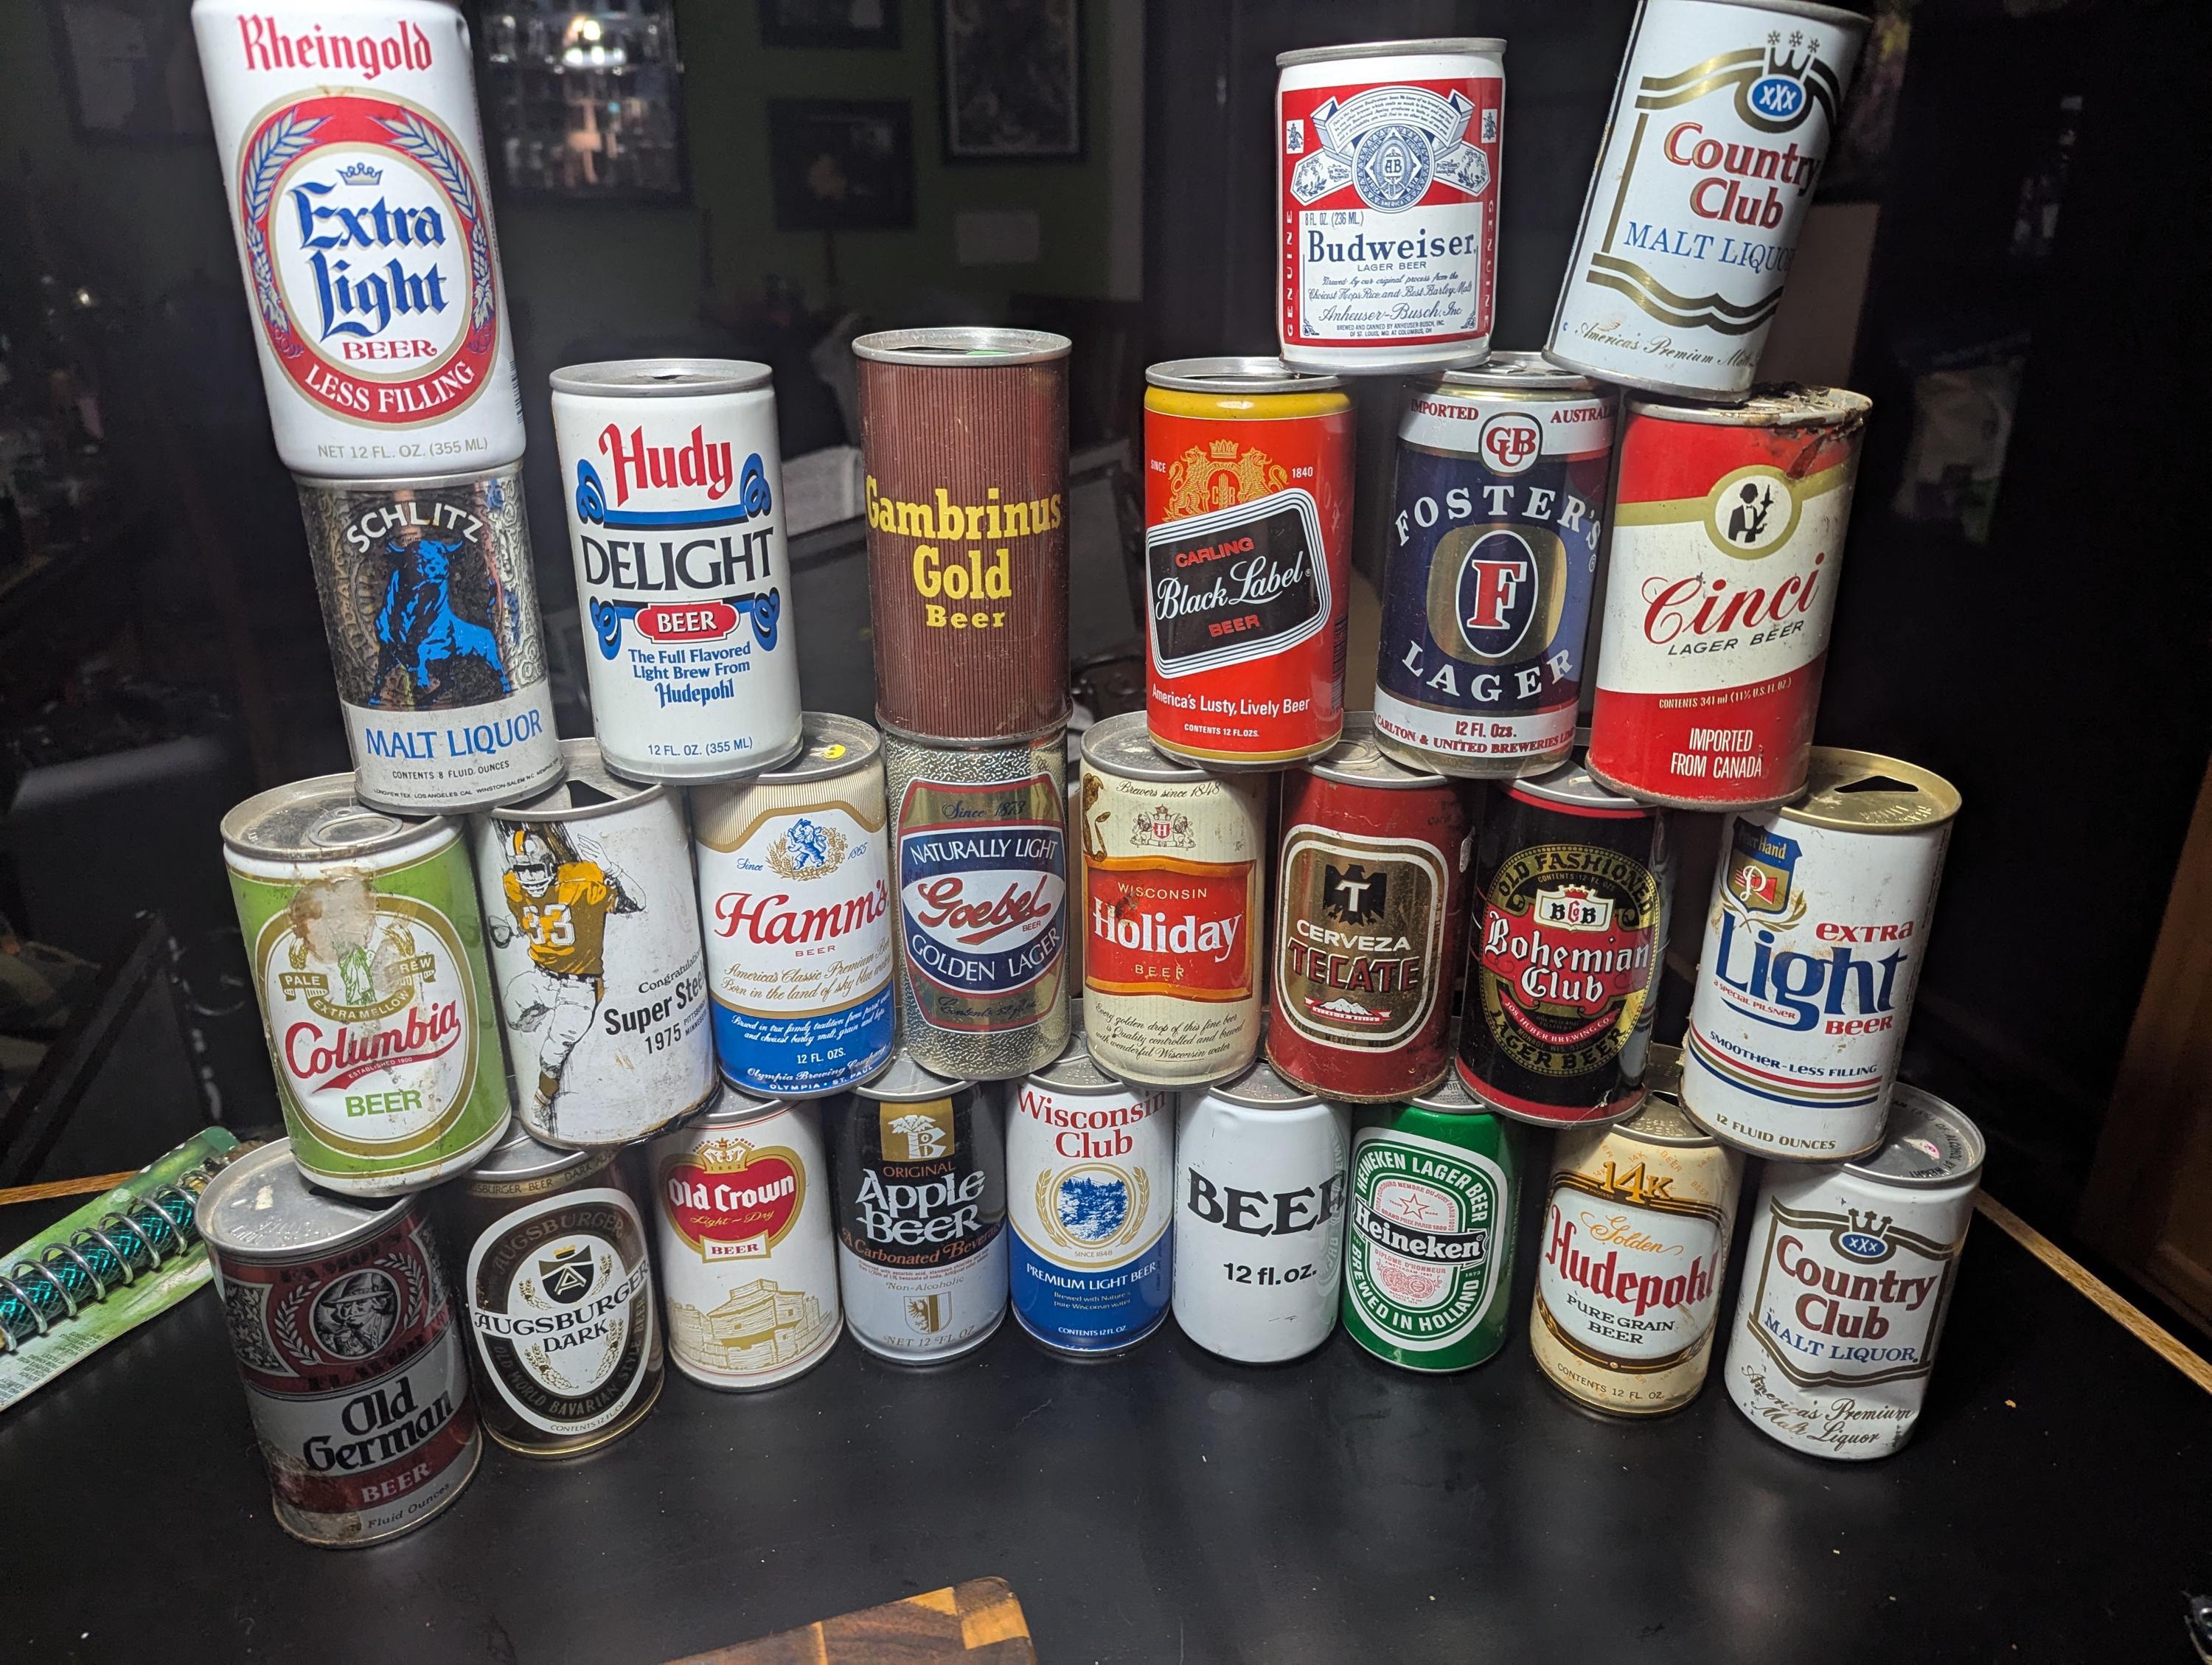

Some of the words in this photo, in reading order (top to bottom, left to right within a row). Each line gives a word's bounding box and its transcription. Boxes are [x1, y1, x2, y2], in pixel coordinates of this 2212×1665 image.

[238, 15, 433, 80] Rheingold
[1663, 121, 1823, 198] Country
[288, 182, 446, 249] Extra
[1689, 177, 1784, 230] Club
[1308, 228, 1474, 263] Budweiser
[1357, 263, 1394, 271] LAGER
[1399, 262, 1427, 270] BEER
[310, 250, 450, 343] Light
[344, 341, 437, 361] BEER
[305, 364, 369, 412] LESS
[378, 361, 475, 414] FILLING
[318, 444, 344, 458] NET
[350, 445, 367, 459] 12
[372, 445, 395, 458] FL.
[399, 443, 425, 458] OZ.
[429, 441, 462, 456] (355
[465, 438, 488, 453] ML)
[599, 423, 733, 507] Hudy
[1150, 459, 1166, 473] SINCE
[1291, 465, 1314, 478] 1840
[347, 502, 484, 553] SCHLITZ
[864, 474, 1061, 540] Gambrinus
[1395, 485, 1601, 552] FOSTER'S
[580, 526, 773, 591] DELIGHT
[913, 543, 1012, 600] Gold
[1175, 536, 1254, 568] CARLING
[1155, 577, 1228, 621] Black
[1228, 555, 1304, 605] Label
[1467, 560, 1527, 629] F
[1641, 552, 1825, 646] Cinci
[658, 610, 717, 634] BEER
[925, 603, 1006, 630] Beer
[1208, 614, 1260, 638] BEER
[628, 649, 655, 664] The
[659, 649, 686, 664] Full
[690, 642, 751, 662] Flavored
[1667, 638, 1738, 656] LAGER
[1750, 620, 1804, 645] BEER
[633, 664, 669, 681] Light
[674, 667, 710, 679] Brew
[715, 661, 751, 676] From
[1402, 639, 1573, 701] LAGER
[655, 678, 734, 709] Hudepohl
[1152, 683, 1196, 711] America's
[1200, 695, 1237, 716] Lusty,
[1239, 698, 1280, 717] Lively
[1282, 696, 1311, 713] Beer
[366, 729, 437, 759] MALT
[447, 709, 543, 757] LIQUOR
[1689, 728, 1753, 752] IMPORTED
[392, 771, 434, 779] CONTENTS
[448, 768, 473, 778] FLUID
[478, 760, 509, 774] OUNCES
[1671, 752, 1707, 777] FROM
[1713, 756, 1762, 779] CANADA
[1116, 781, 1158, 796] Brewers
[1161, 788, 1188, 799] since
[1190, 780, 1220, 799] 1848
[909, 838, 1012, 866] NATURALLY
[1015, 838, 1058, 861] LIGHT
[1759, 835, 1787, 860] Hand
[1118, 881, 1208, 900] WISCONSIN
[1498, 861, 1530, 897] OLD
[1534, 852, 1653, 916] FASHIONED
[714, 878, 888, 946] Hamm's
[918, 874, 1052, 946] Goebel
[1022, 921, 1041, 932] BEER
[1093, 896, 1242, 963] Holiday
[795, 945, 836, 957] BEER
[912, 934, 995, 982] GOLDEN
[1009, 927, 1060, 979] LAGER
[1296, 919, 1411, 953] CERVEZA
[1484, 911, 1651, 973] Bohemian
[1135, 964, 1185, 978] BEER
[1287, 936, 1419, 994] TECATE
[1520, 967, 1604, 1003] Club
[1714, 909, 1907, 1032] Light
[313, 998, 357, 1019] EXTRA
[359, 990, 409, 1019] MELLOW
[604, 996, 672, 1035] Super
[1095, 1003, 1114, 1023] Every
[1116, 1016, 1144, 1029] golden
[1147, 1023, 1169, 1036] drop
[1171, 1026, 1183, 1036] of
[1183, 1021, 1200, 1032] this
[1202, 1018, 1221, 1035] fine
[1223, 1013, 1238, 1025] beer
[1505, 1001, 1518, 1017] JOS.
[1520, 1017, 1548, 1041] HUBER
[1551, 1028, 1597, 1043] BREWING
[1598, 1017, 1612, 1028] CO.
[285, 1000, 462, 1080] Columbia
[645, 1023, 681, 1054] 1975
[796, 1054, 807, 1064] 12
[811, 1053, 824, 1063] FL.
[827, 1048, 846, 1060] OZS.
[1489, 1010, 1552, 1068] LAGER
[1562, 1028, 1627, 1068] BEER
[345, 1090, 422, 1118] BEER
[1017, 1084, 1166, 1130] Wisconsin
[1055, 1131, 1133, 1158] Club
[1717, 1113, 1728, 1125] 12
[1733, 1122, 1774, 1142] FLUID
[1778, 1136, 1835, 1150] OUNCES
[883, 1164, 956, 1178] ORIGINAL
[1357, 1150, 1406, 1194] HEINEKEN
[1412, 1156, 1472, 1190] LAGER
[1465, 1182, 1489, 1223] BEER
[1603, 1161, 1674, 1204] 14K
[667, 1178, 711, 1211] Old
[714, 1175, 795, 1212] Crown
[1187, 1167, 1346, 1237] BEER
[689, 1216, 729, 1227] Light
[744, 1209, 774, 1223] Dry
[1356, 1201, 1482, 1257] Heineken
[1581, 1211, 1684, 1255] Golden
[493, 1211, 623, 1274] AUGSBURGER
[712, 1242, 759, 1254] BEER
[1545, 1204, 1719, 1316] Hudepohl
[886, 1276, 964, 1291] Non-Alcoholic
[1026, 1262, 1085, 1289] PREMIUM
[1089, 1276, 1128, 1290] LIGHT
[1130, 1262, 1156, 1284] BEER
[1352, 1243, 1388, 1319] BREWED
[1393, 1311, 1412, 1330] IN
[1419, 1279, 1480, 1332] HOLLAND
[1776, 1235, 1938, 1310] Country
[474, 1262, 649, 1335] AUGSBURGER
[1567, 1293, 1614, 1324] PURE
[1617, 1317, 1675, 1331] GRAIN
[1795, 1294, 1889, 1340] Club
[543, 1319, 608, 1353] DARK
[1058, 1327, 1098, 1335] CONTENTS
[1587, 1321, 1644, 1344] BEER
[1764, 1313, 1823, 1356] MALT
[340, 1376, 418, 1435] Old
[302, 1391, 453, 1473] German
[361, 1462, 431, 1504] BEER
[367, 1510, 403, 1529] Fluid
[406, 1483, 451, 1515] Ounces
